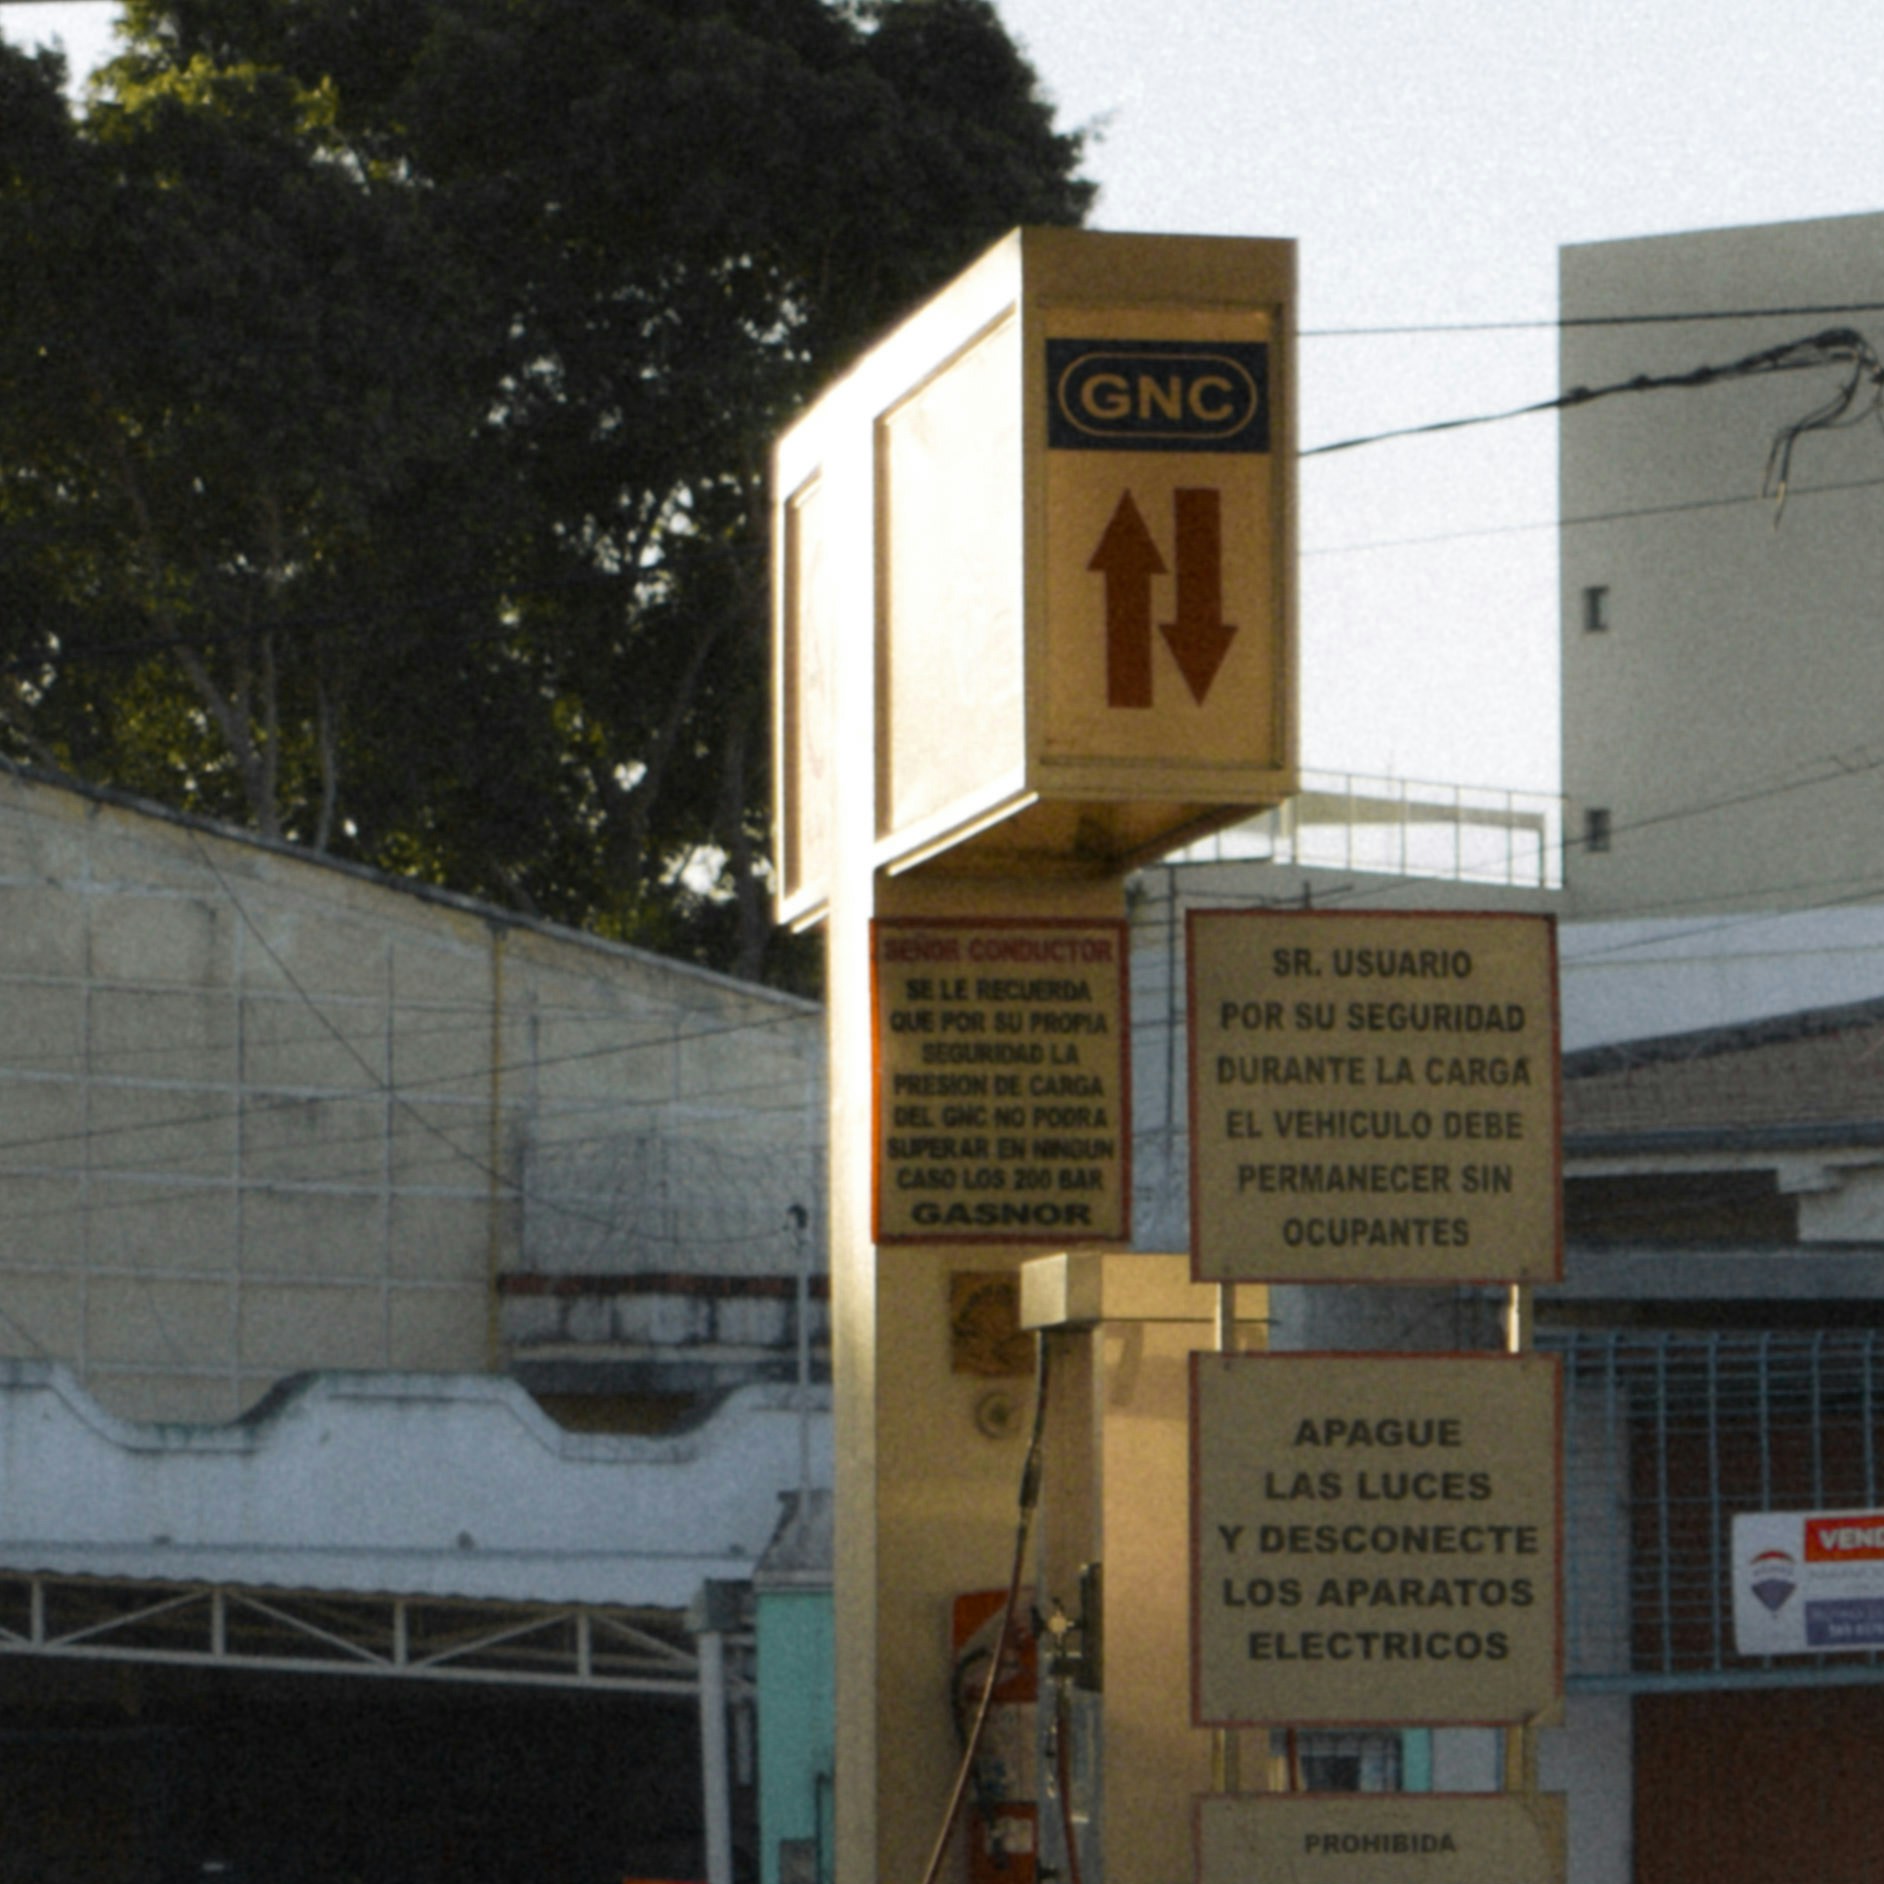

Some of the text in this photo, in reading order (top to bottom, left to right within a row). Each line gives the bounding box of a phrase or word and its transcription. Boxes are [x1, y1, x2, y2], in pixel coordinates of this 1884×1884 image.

[1080, 373, 1234, 420] GNC
[968, 939, 1113, 962] CONDUCTOR
[1272, 948, 1472, 978] SR. USUARIO
[906, 979, 1092, 1001] SE LE RECUERDA
[890, 1011, 1107, 1034] QUE POR SU PROPIA
[1220, 1002, 1526, 1032] POR SU SEGURIDAD
[921, 1043, 1079, 1065] SEGURIDAD LA
[893, 1074, 1103, 1096] PRESION DE CARGA
[1216, 1056, 1532, 1086] DURANTE LA CARGA
[893, 1106, 1107, 1128] DEL GNC NO PODRA
[1226, 1110, 1524, 1139] EL VEHICULO DEBE
[887, 1138, 1114, 1159] SUPERAR EN NINGUN
[897, 1168, 1103, 1190] CASO LOS 200 BAR
[1238, 1165, 1514, 1193] PERMANECER SIN
[911, 1203, 1092, 1226] GASNOR
[1283, 1218, 1470, 1247] OCUPANTES
[1293, 1419, 1462, 1447] APAGUE
[1264, 1472, 1493, 1501] LAS LUCES
[1218, 1525, 1539, 1554] Y DESCONECTE
[1222, 1579, 1534, 1607] LOS APARATOS
[1248, 1632, 1509, 1660] ELECTRICOS
[1305, 1834, 1456, 1854] PROHIBIDA
